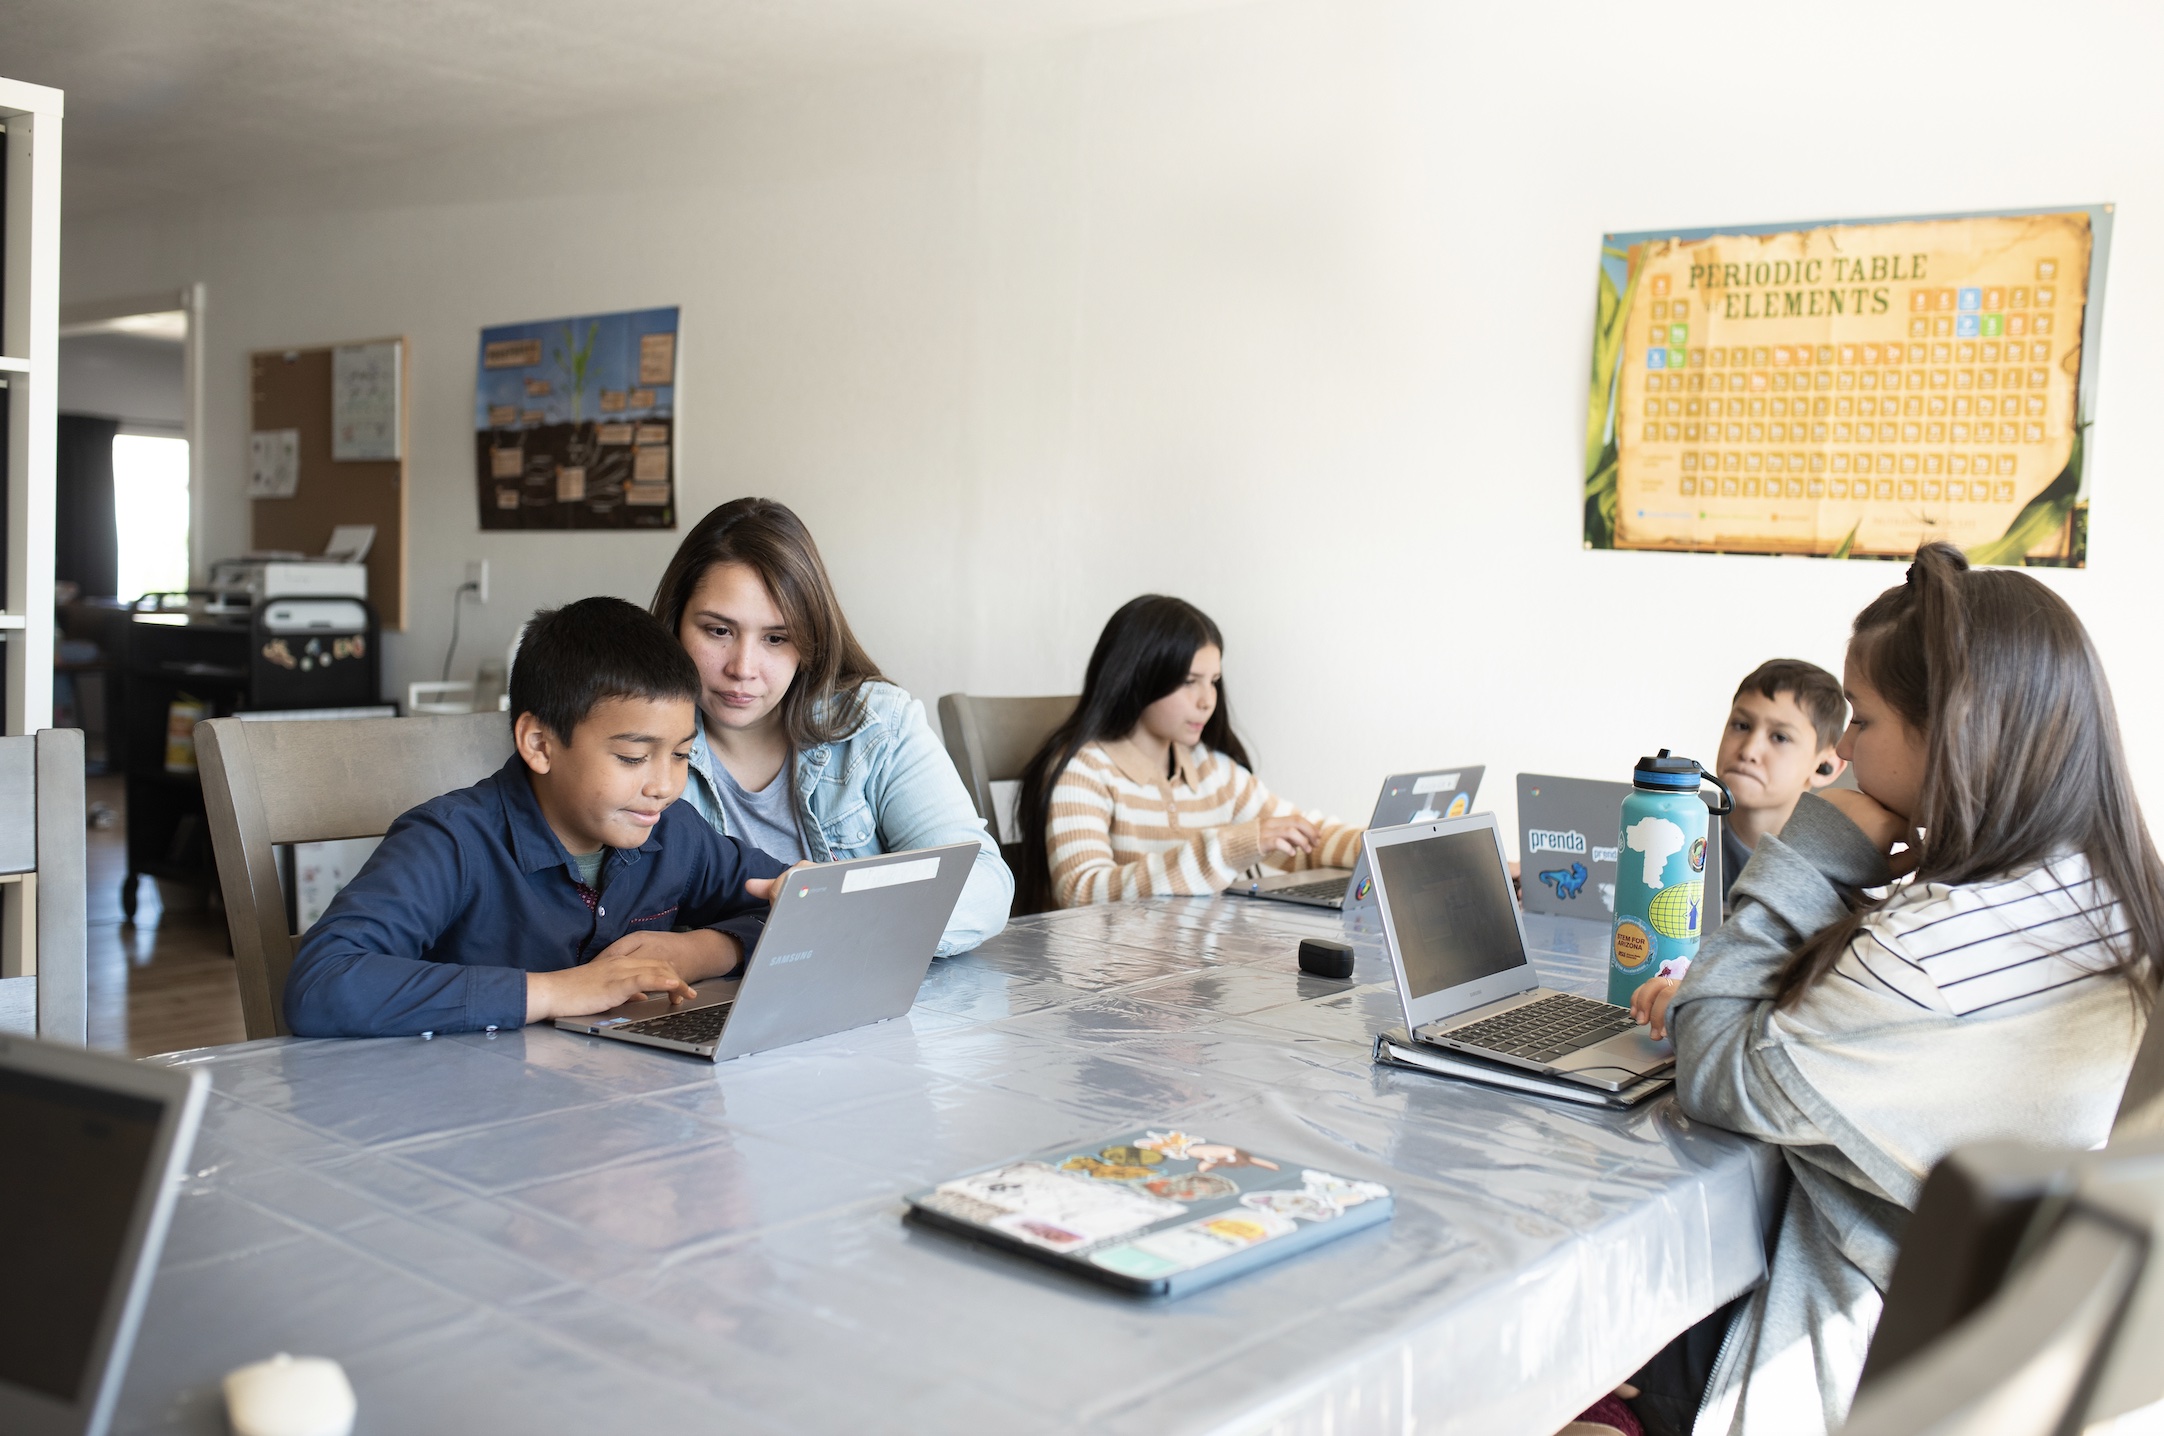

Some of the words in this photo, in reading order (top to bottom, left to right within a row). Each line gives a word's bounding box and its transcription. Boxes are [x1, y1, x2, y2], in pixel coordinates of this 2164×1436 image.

[1689, 258, 1822, 289] PERIODIC
[1832, 253, 1928, 282] TABLE
[1724, 286, 1890, 319] ELEMENTS
[1531, 832, 1584, 851] prenda
[1594, 849, 1617, 860] prend
[1617, 941, 1642, 950] ARIZONA
[1632, 936, 1645, 945] FOR
[769, 950, 813, 967] SAMSUNG
